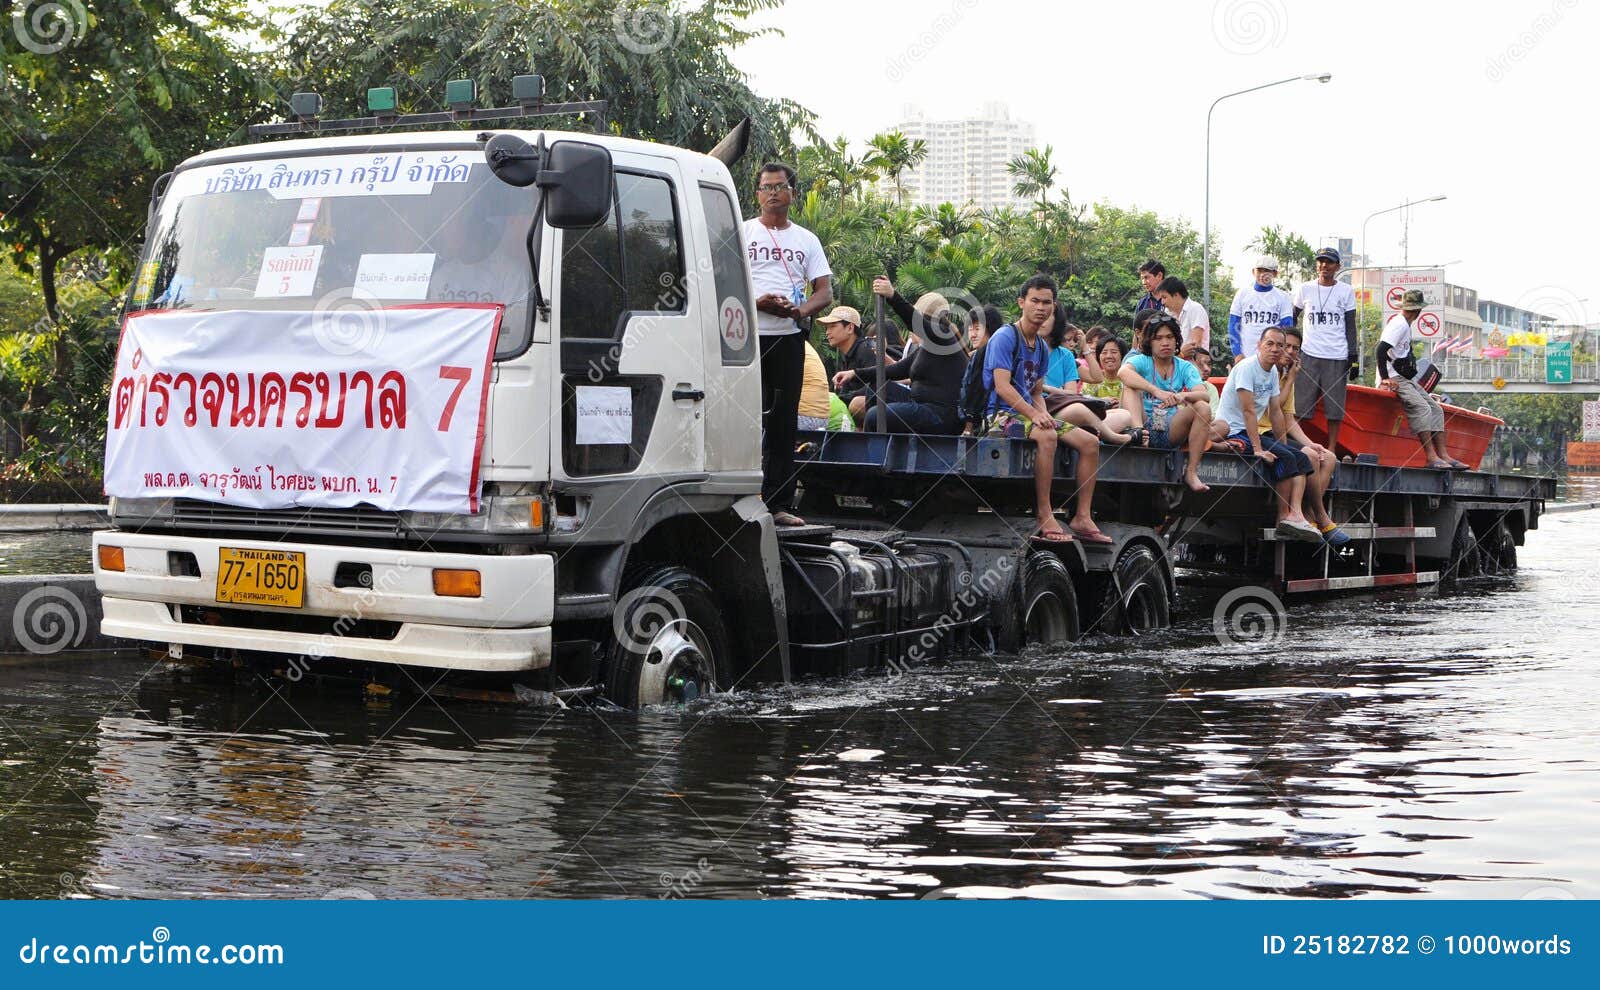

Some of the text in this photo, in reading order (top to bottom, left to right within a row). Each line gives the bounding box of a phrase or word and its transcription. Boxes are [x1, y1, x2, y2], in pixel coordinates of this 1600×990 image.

[204, 155, 469, 194] บริษัท สินทรา กรุ๊ป จำกัด
[748, 241, 805, 264] ตำรวจ
[725, 307, 745, 340] 23
[1244, 305, 1279, 324] ตำรวจ
[114, 347, 472, 432] ตำรวจนครบาล 7
[200, 465, 262, 497] จารุวัฒน์
[268, 464, 317, 491] ไวศยะ
[322, 475, 361, 493] ผบก.
[368, 477, 382, 494] น.
[390, 476, 398, 493] 7
[239, 551, 284, 561] THAILAND
[222, 560, 299, 590] 77-1650
